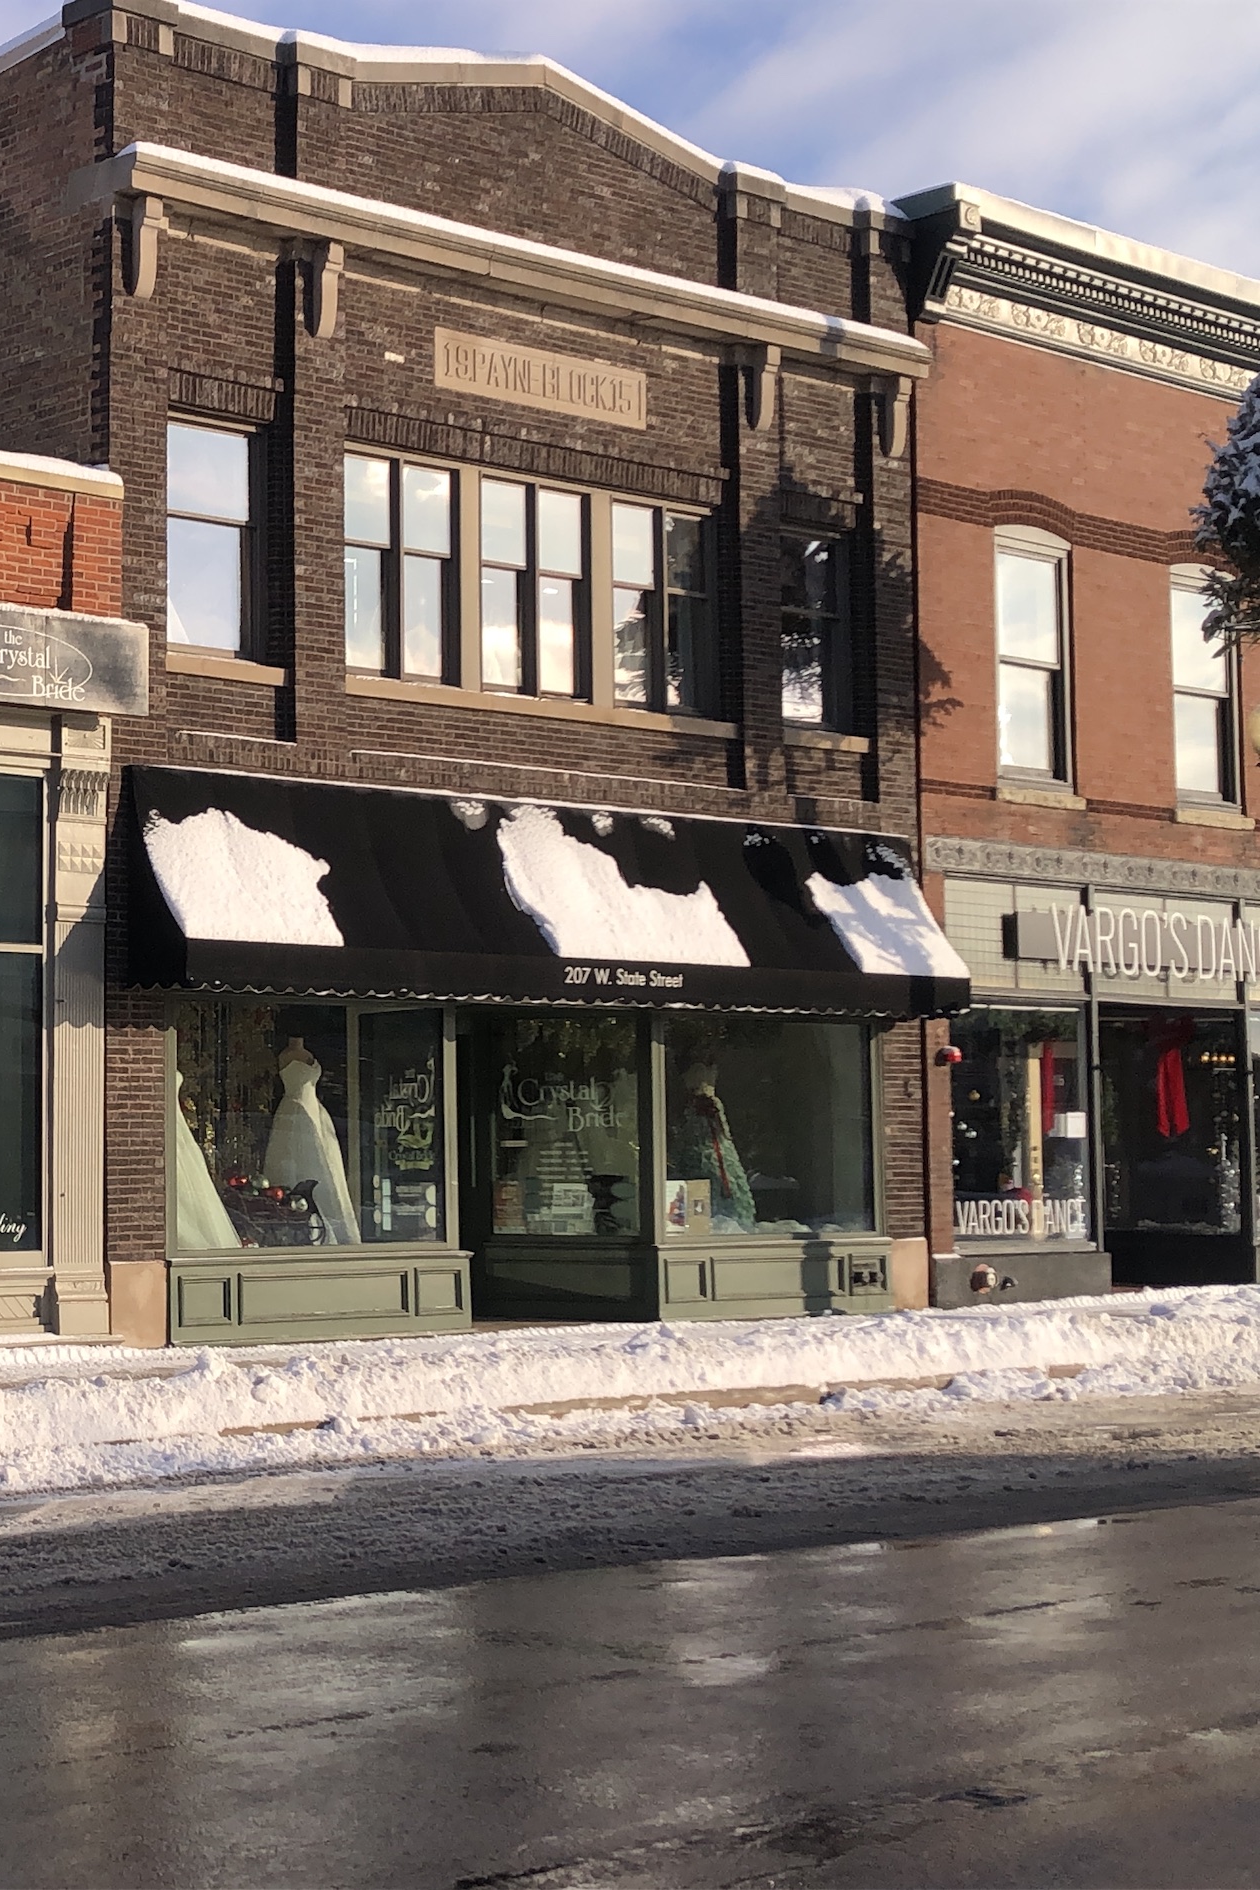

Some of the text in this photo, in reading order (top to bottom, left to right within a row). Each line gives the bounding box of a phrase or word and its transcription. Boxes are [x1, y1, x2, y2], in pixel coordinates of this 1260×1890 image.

[473, 348, 541, 397] PAYNE
[4, 630, 23, 646] the
[32, 675, 86, 702] Bride
[1051, 902, 1260, 983] VARGO'S DAN
[564, 966, 684, 988] 207 W. State Street
[517, 1076, 597, 1110] Crystal
[956, 1198, 1087, 1235] VARGO'S DANCE
